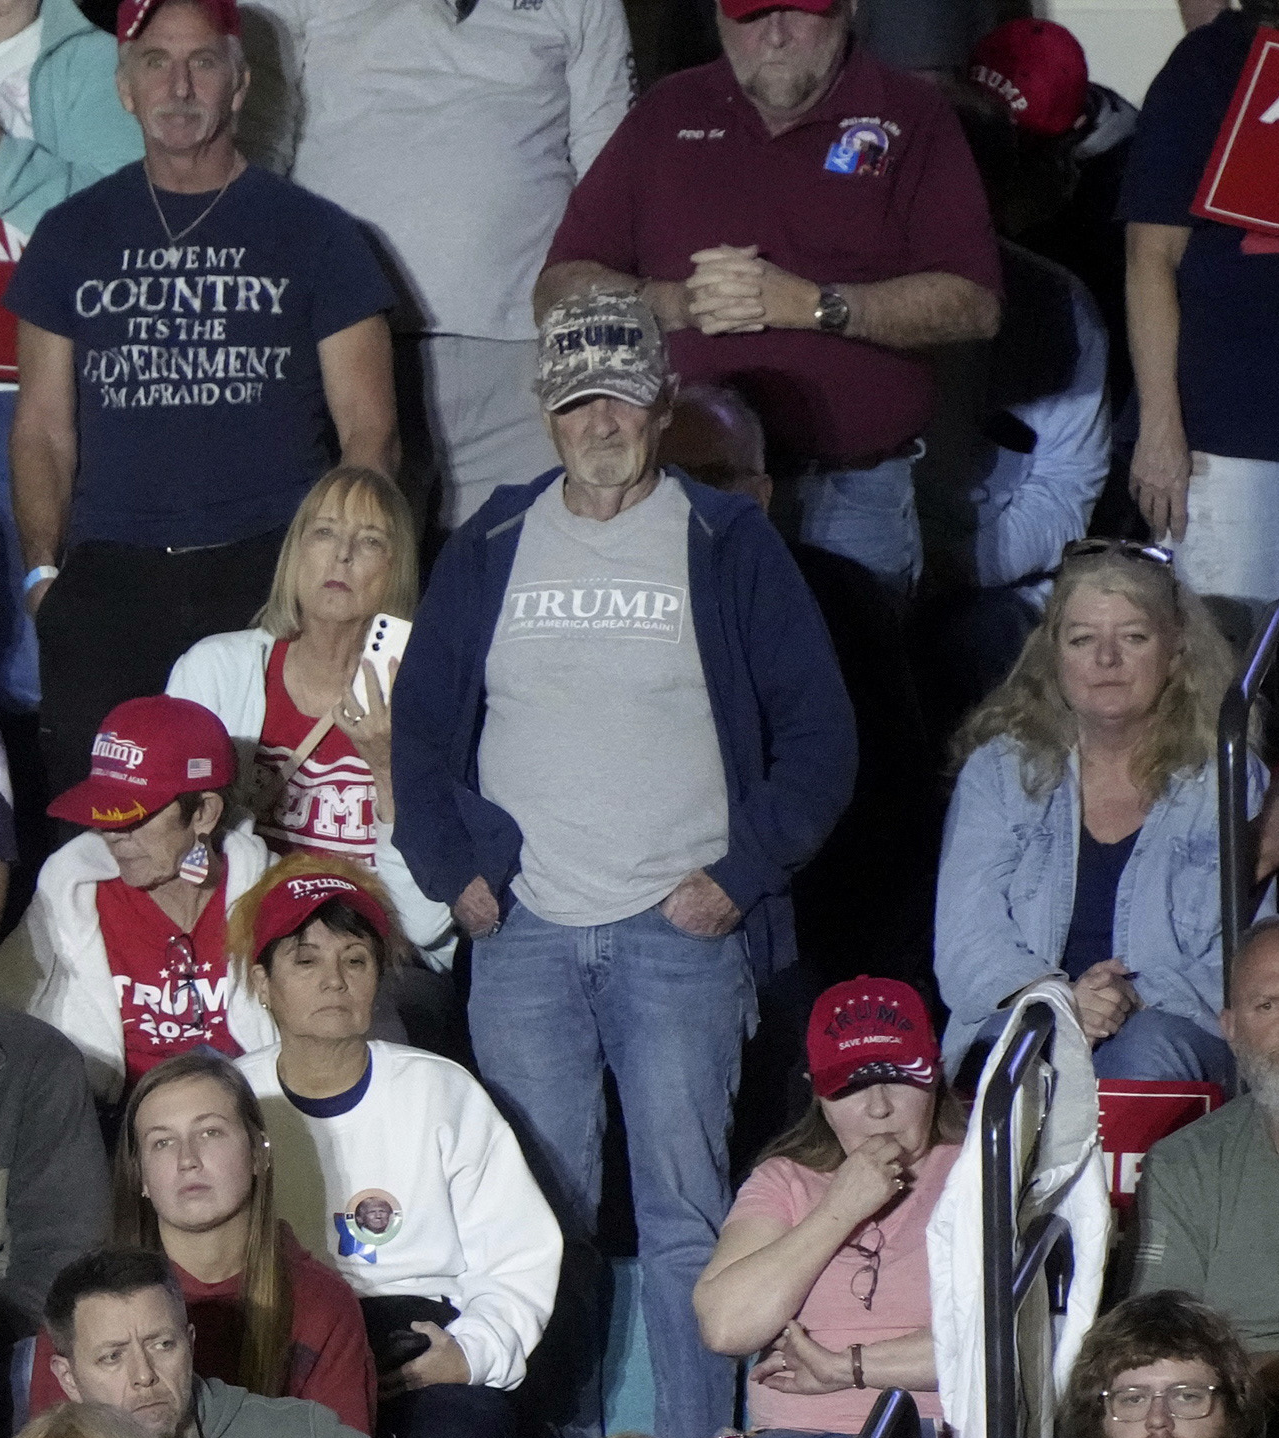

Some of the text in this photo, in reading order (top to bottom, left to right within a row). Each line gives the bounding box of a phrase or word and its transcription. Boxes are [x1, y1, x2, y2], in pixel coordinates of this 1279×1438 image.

[121, 246, 247, 271] I LOVE MY
[75, 275, 291, 320] COUNTRY
[126, 316, 227, 342] IT'S THE
[553, 325, 645, 357] TRUMP
[81, 345, 292, 386] GOVERNMENT
[128, 382, 219, 407] AFRAID
[509, 586, 680, 622] TRUMP
[540, 618, 675, 632] AMERICA GREAT AGAIN!
[838, 1037, 862, 1051] SAVE
